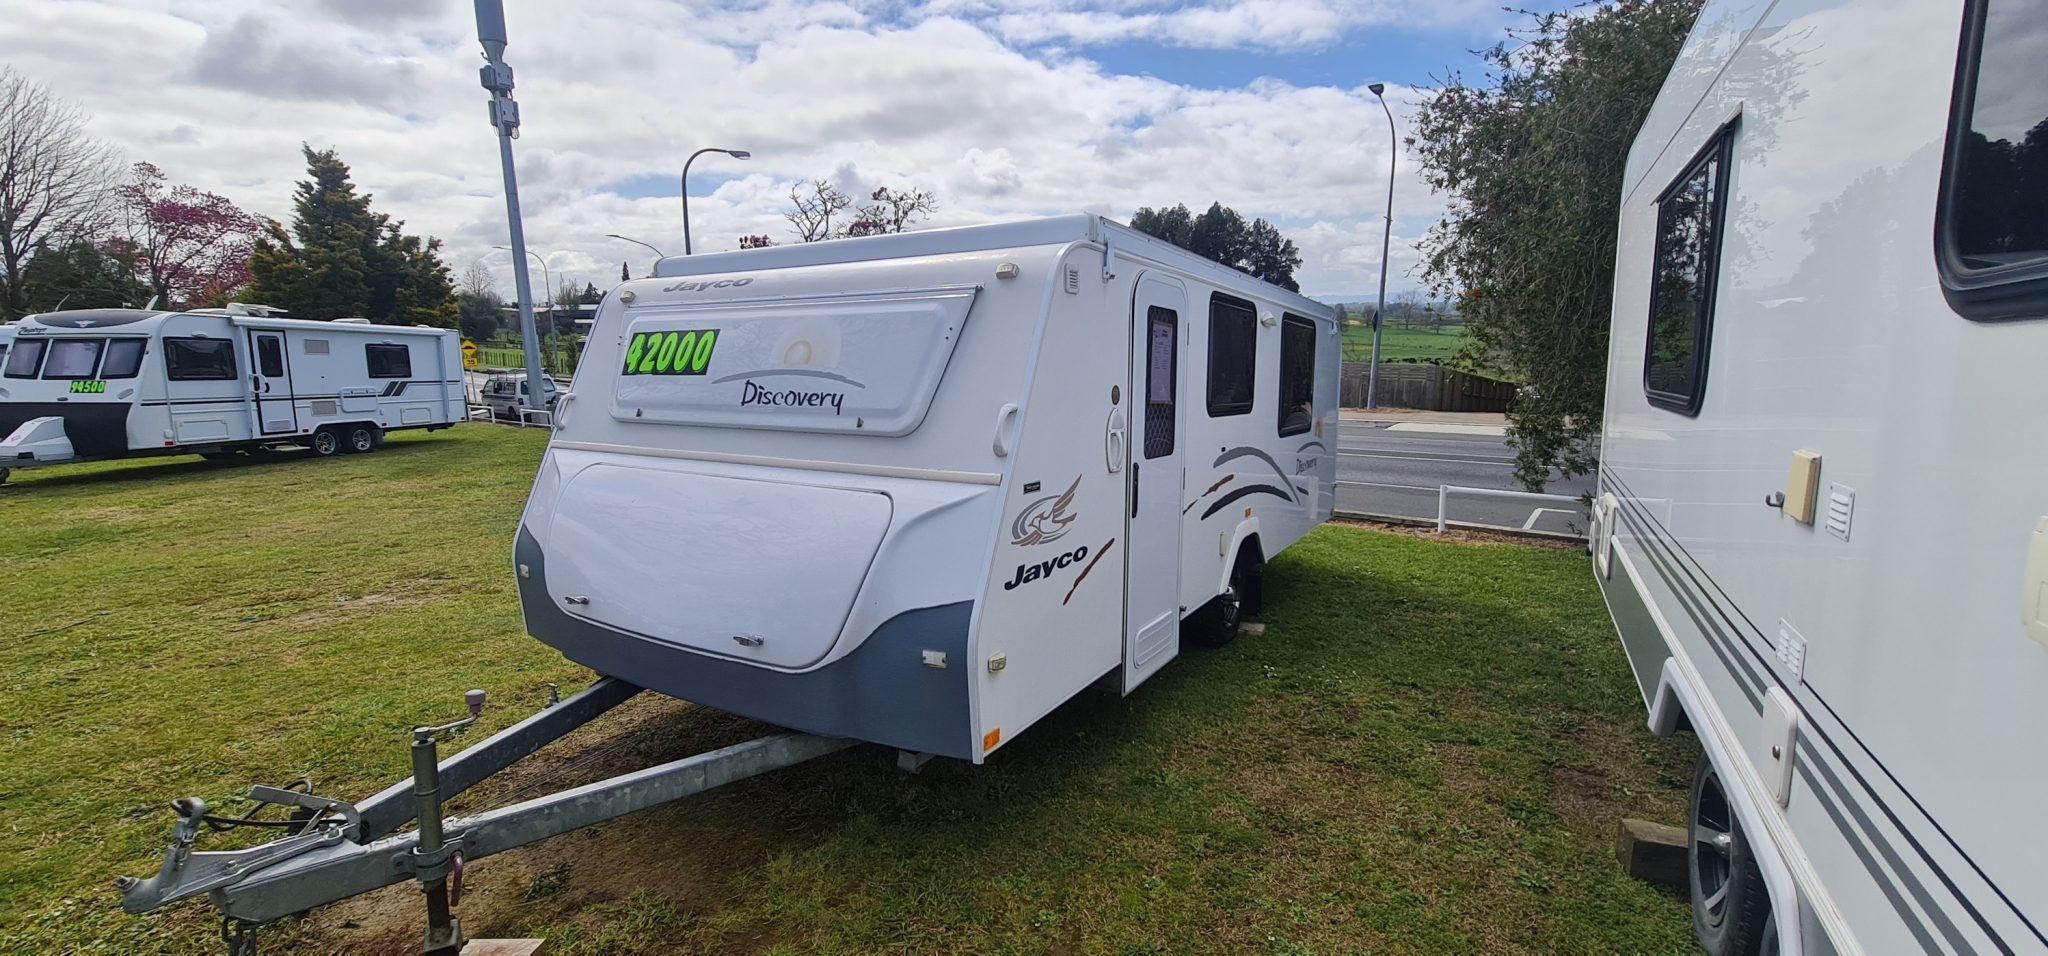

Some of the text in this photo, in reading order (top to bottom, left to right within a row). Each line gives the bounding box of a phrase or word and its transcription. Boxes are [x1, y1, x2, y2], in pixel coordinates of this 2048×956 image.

[663, 278, 754, 293] Jayco
[625, 330, 716, 375] 42000
[71, 381, 105, 393] 94500
[740, 379, 844, 415] Discovery
[1296, 457, 1317, 476] Discovery
[1003, 546, 1089, 591] Jayco
